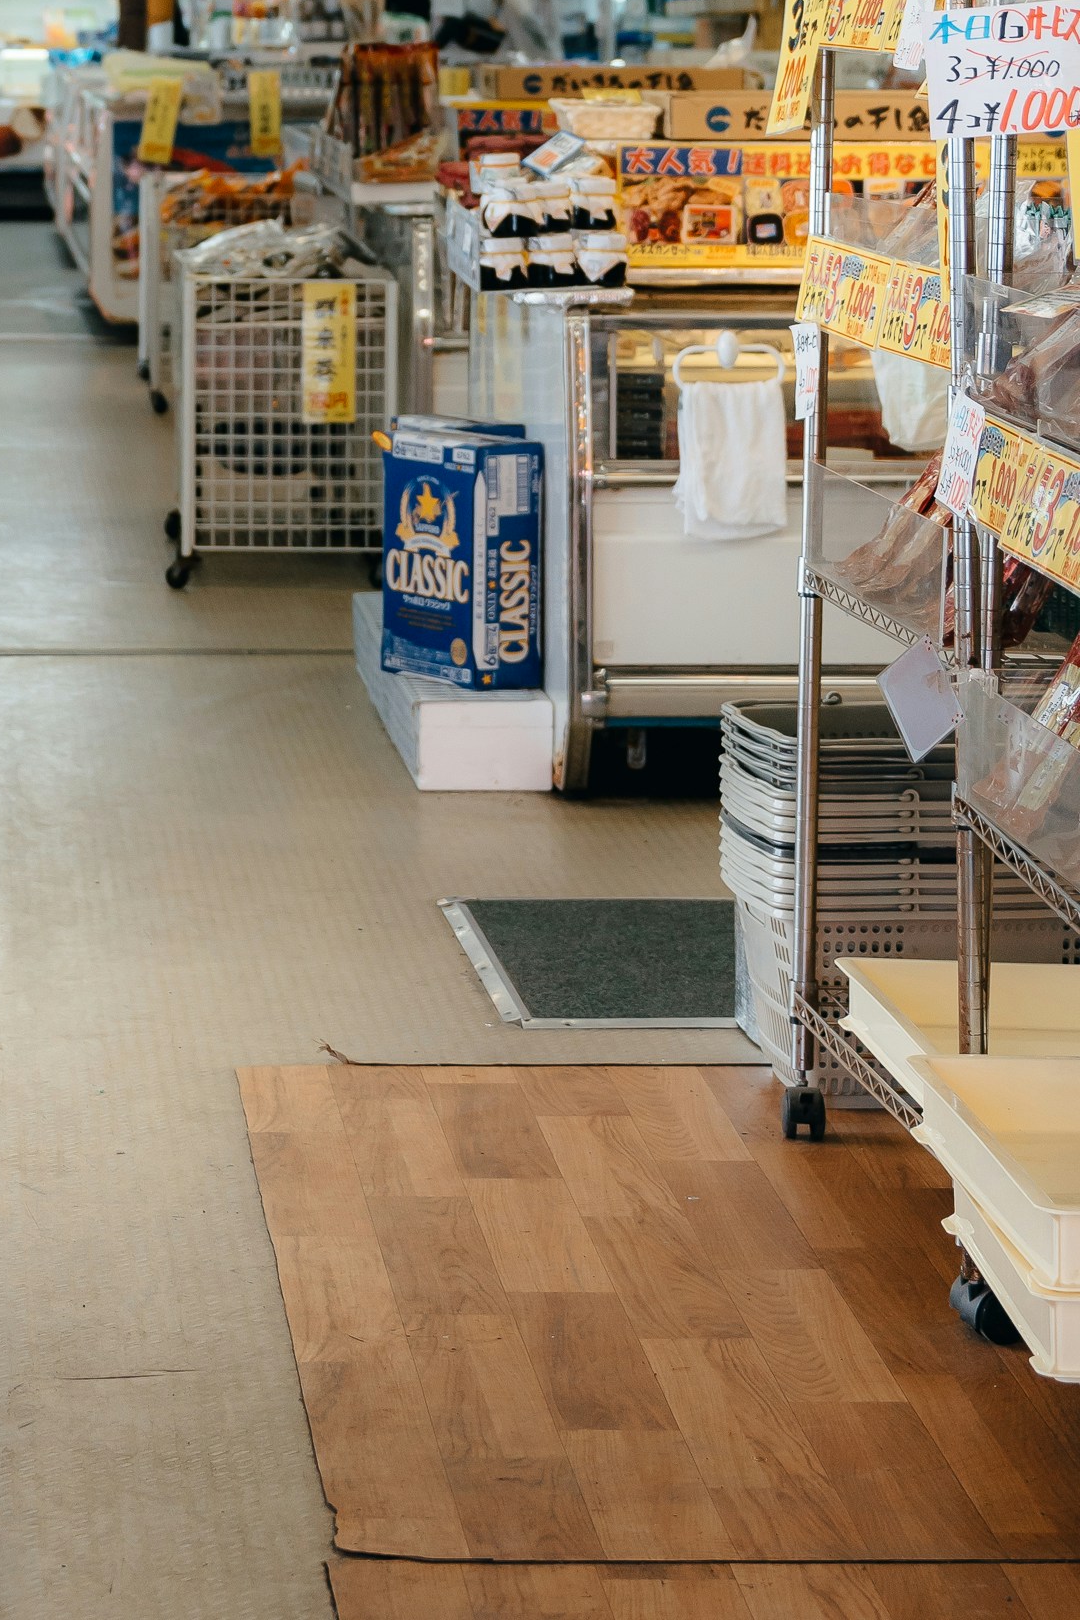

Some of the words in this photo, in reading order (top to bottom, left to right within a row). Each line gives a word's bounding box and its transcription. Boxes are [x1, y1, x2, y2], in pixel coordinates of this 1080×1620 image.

[625, 148, 740, 176] 大人気！
[386, 548, 469, 604] CLASSIC
[499, 539, 531, 663] CLASSIC
